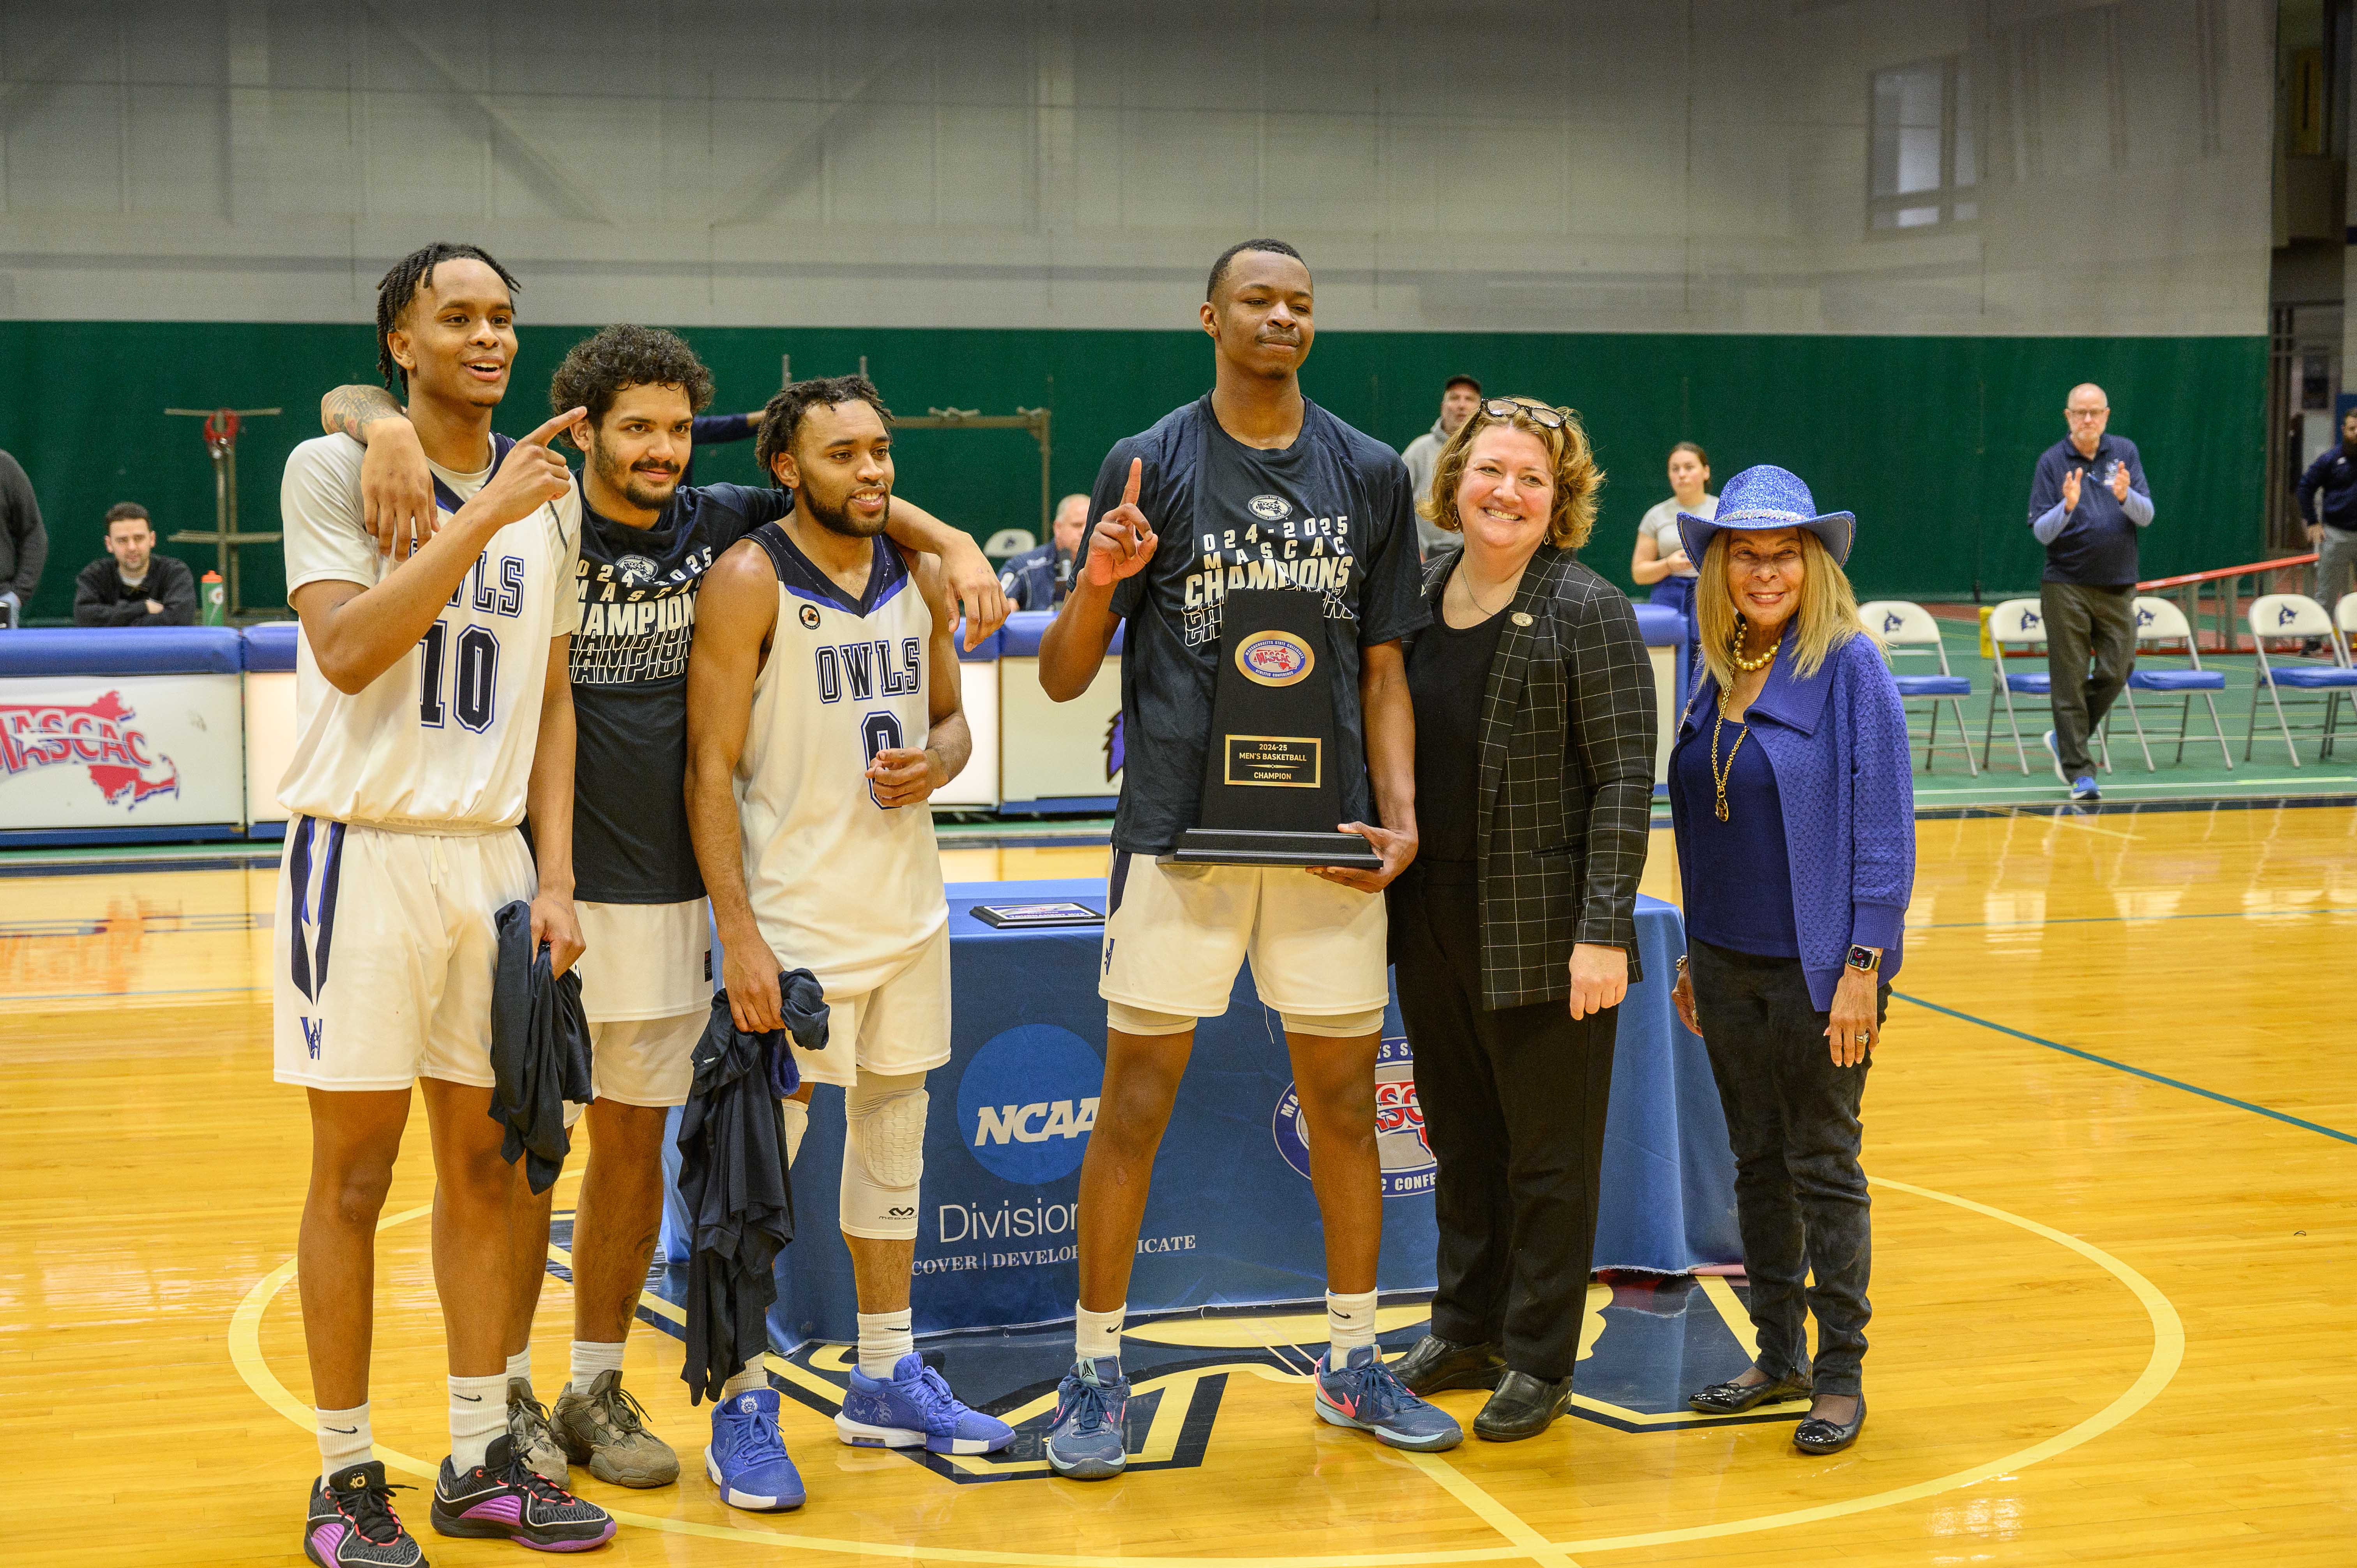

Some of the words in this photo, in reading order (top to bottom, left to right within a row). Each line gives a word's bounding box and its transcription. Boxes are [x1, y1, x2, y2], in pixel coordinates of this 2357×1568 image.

[1203, 536, 1345, 569] MASCAC
[1185, 556, 1353, 607] CHAMPIONS
[1245, 641, 1274, 656] MASSACHUSETTS
[1286, 643, 1305, 659] COLLEGIATE
[1255, 651, 1292, 666] MASCAC
[418, 619, 500, 734] 10
[815, 637, 921, 704] OWLS
[1255, 669, 1271, 677] ATHLETIC
[861, 710, 904, 810] 0
[1262, 753, 1307, 761] BASKETBALL
[1254, 772, 1292, 780] CHAMPION
[975, 1097, 1101, 1146] NCAA
[911, 1255, 978, 1276] COVER
[1136, 1235, 1196, 1254] ICATE
